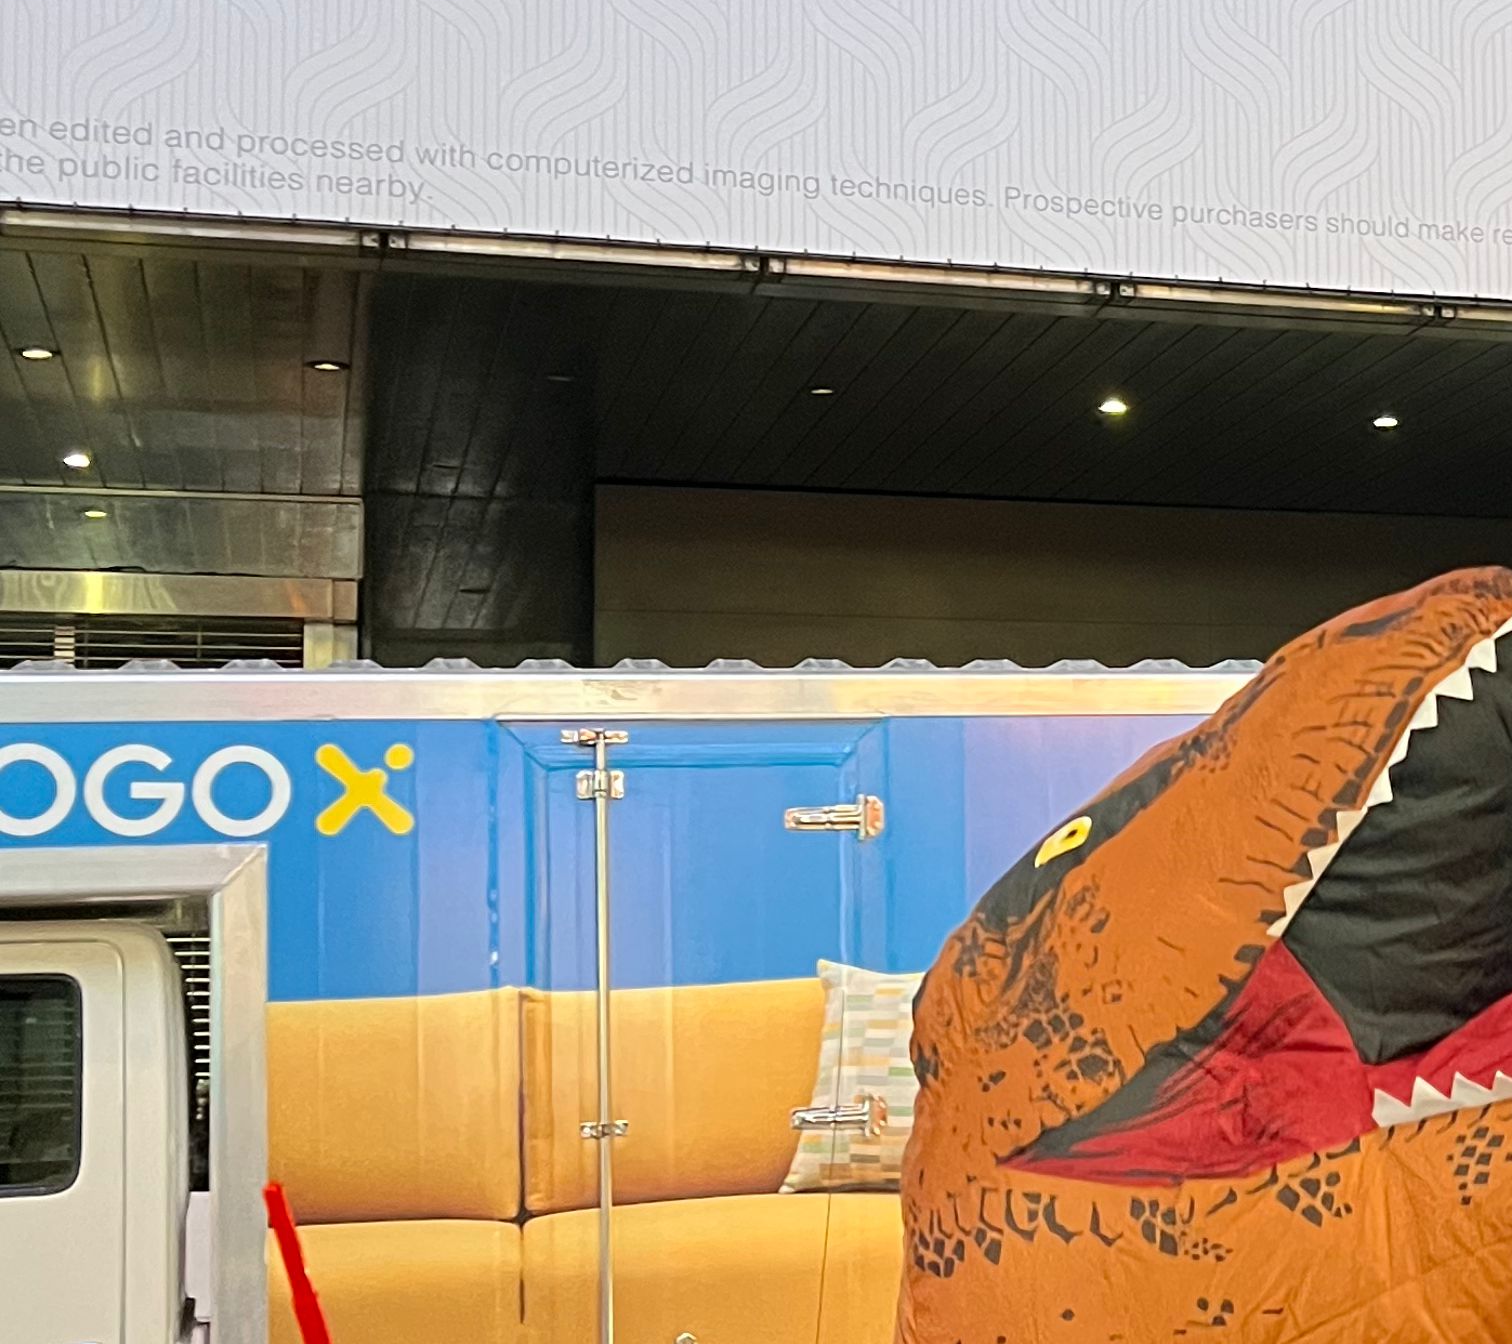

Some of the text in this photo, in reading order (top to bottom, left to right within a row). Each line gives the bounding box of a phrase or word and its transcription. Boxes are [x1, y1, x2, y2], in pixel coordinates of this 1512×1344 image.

[0, 147, 433, 205] he public facilities nearby.
[0, 117, 38, 138] en
[49, 117, 153, 146] edited
[164, 127, 225, 151] and
[237, 132, 404, 163] processed
[415, 142, 475, 168] with
[486, 151, 694, 184] computerized
[704, 163, 820, 199] imaging
[831, 175, 993, 208] techniques.
[1004, 186, 1163, 219] Prospective
[1172, 204, 1318, 232] purchasers
[1326, 212, 1409, 238] should
[1418, 220, 1485, 244] make
